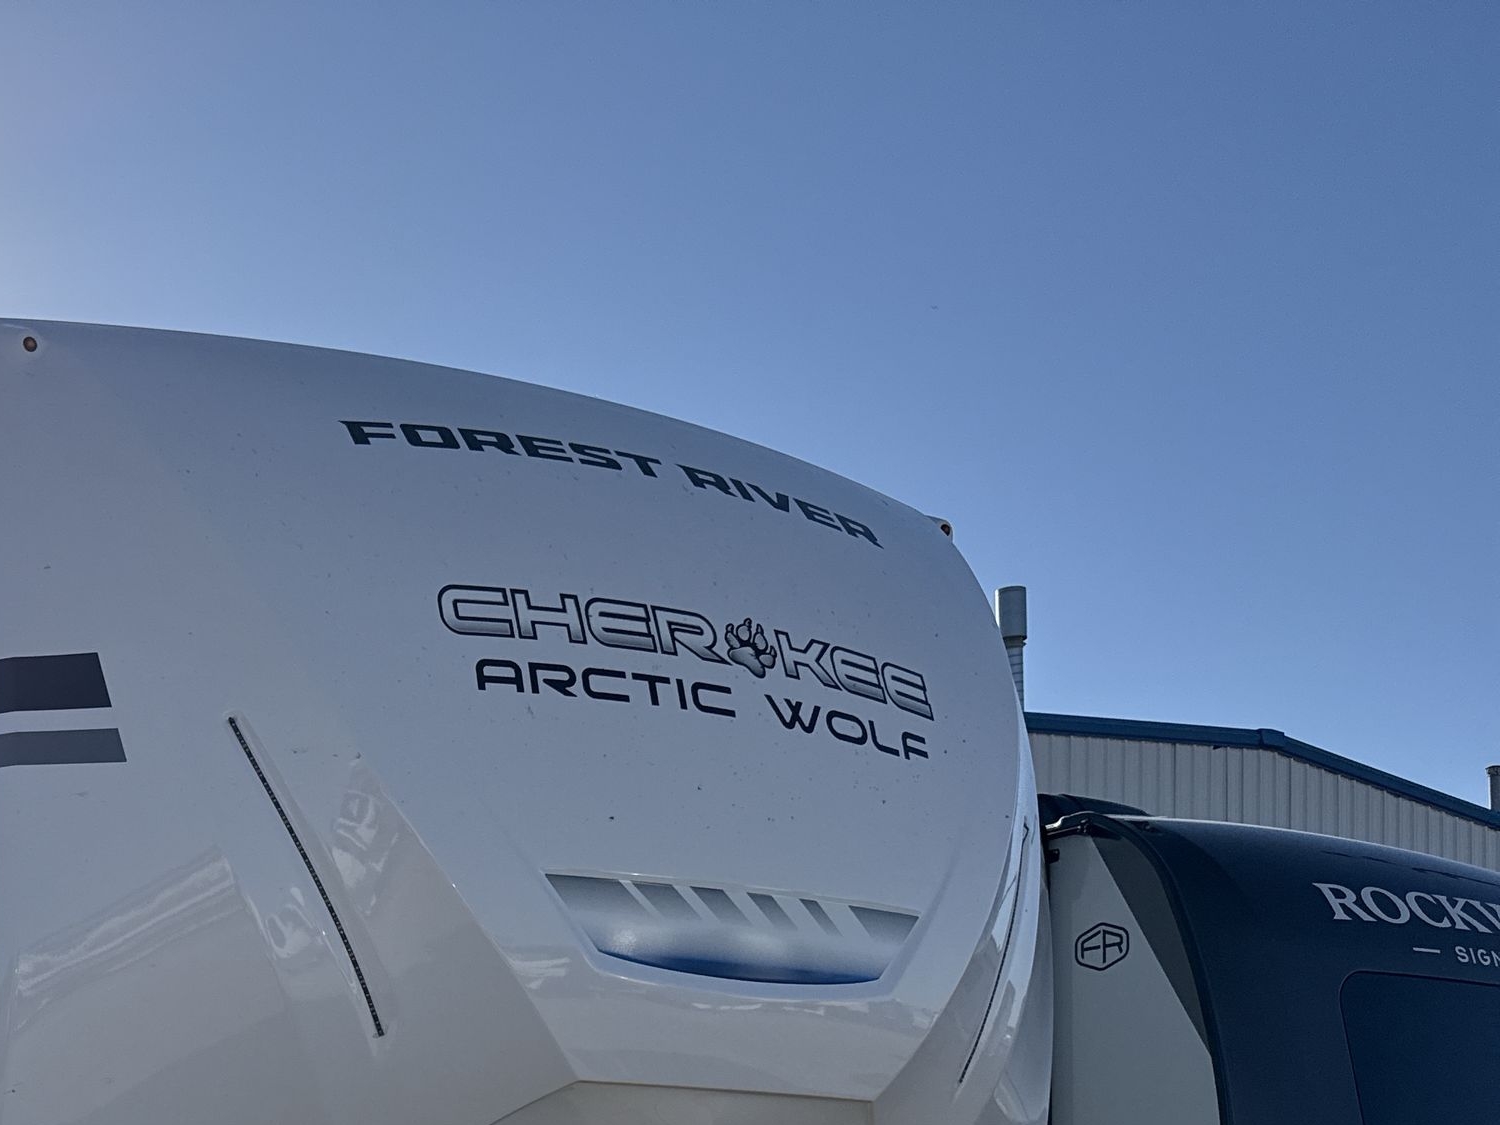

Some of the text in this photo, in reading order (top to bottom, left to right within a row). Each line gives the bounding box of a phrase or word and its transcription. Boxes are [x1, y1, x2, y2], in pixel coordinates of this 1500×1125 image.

[338, 420, 884, 549] FOREST RIVER
[475, 658, 930, 760] ARCTIC WOLF
